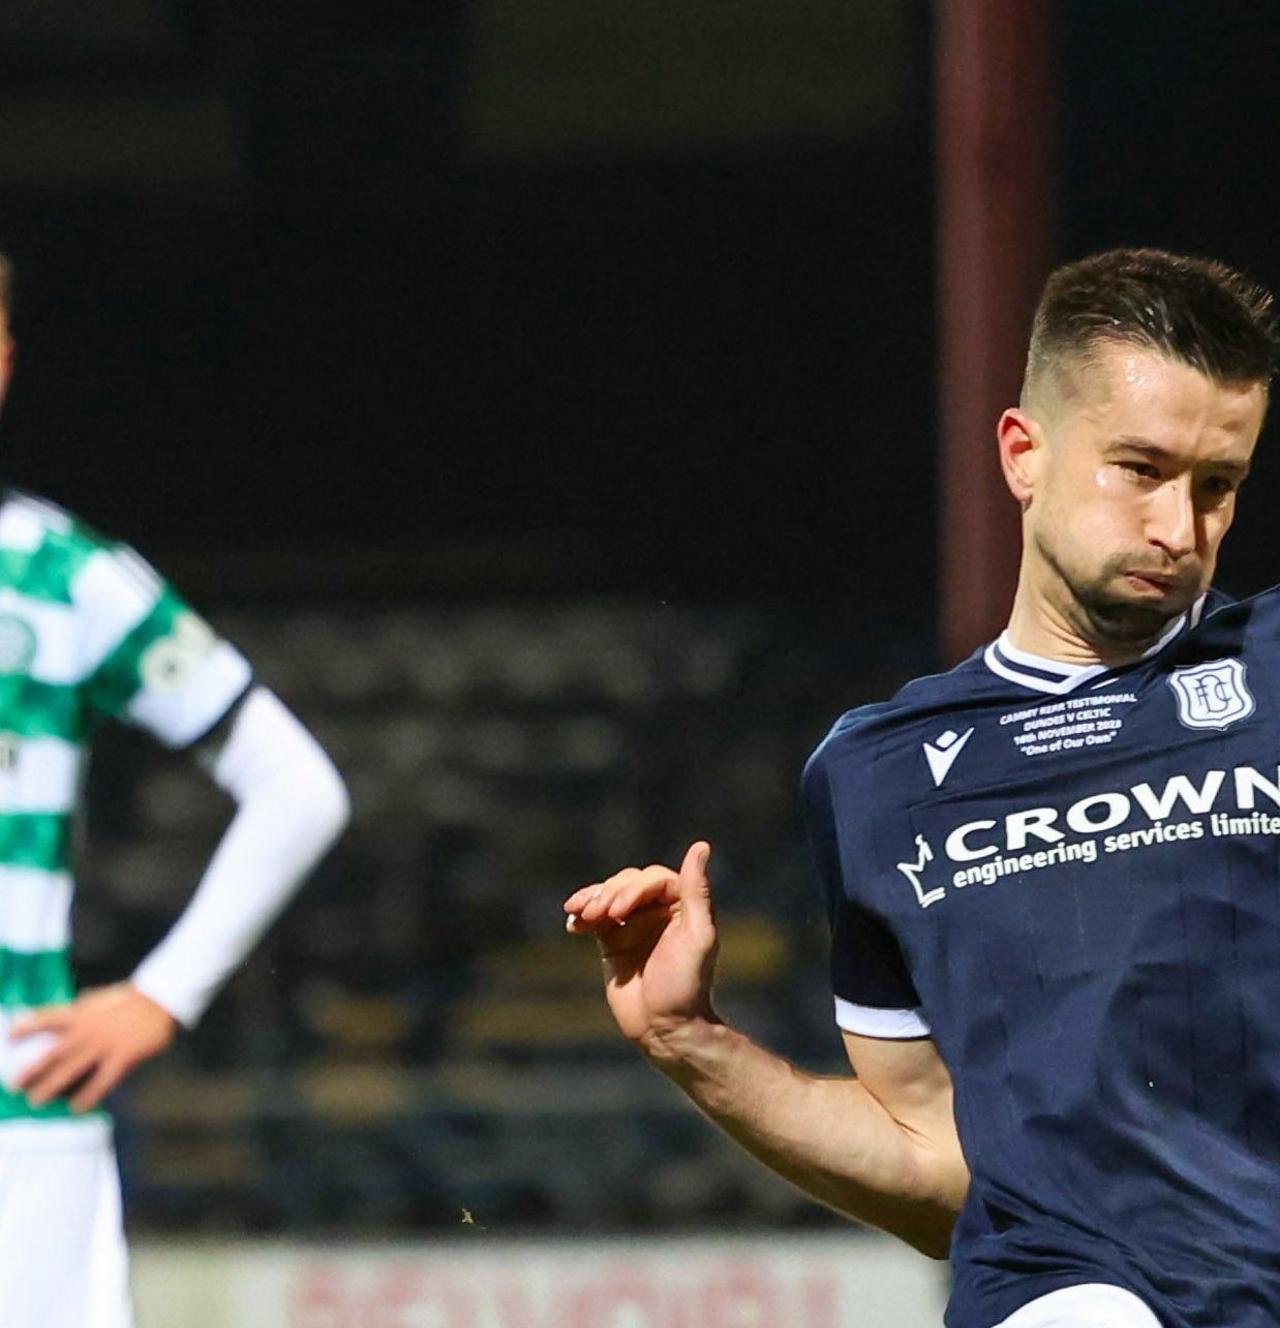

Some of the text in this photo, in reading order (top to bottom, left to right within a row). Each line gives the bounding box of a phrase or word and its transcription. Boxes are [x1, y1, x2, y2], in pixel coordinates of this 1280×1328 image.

[1023, 714, 1066, 732] DUNDEE
[1076, 707, 1112, 721] CELTIC
[1038, 723, 1096, 740] NOVEMBER
[1049, 740, 1062, 751] of
[1063, 738, 1084, 749] Our
[952, 839, 1097, 889] engineering
[1103, 820, 1205, 853] services
